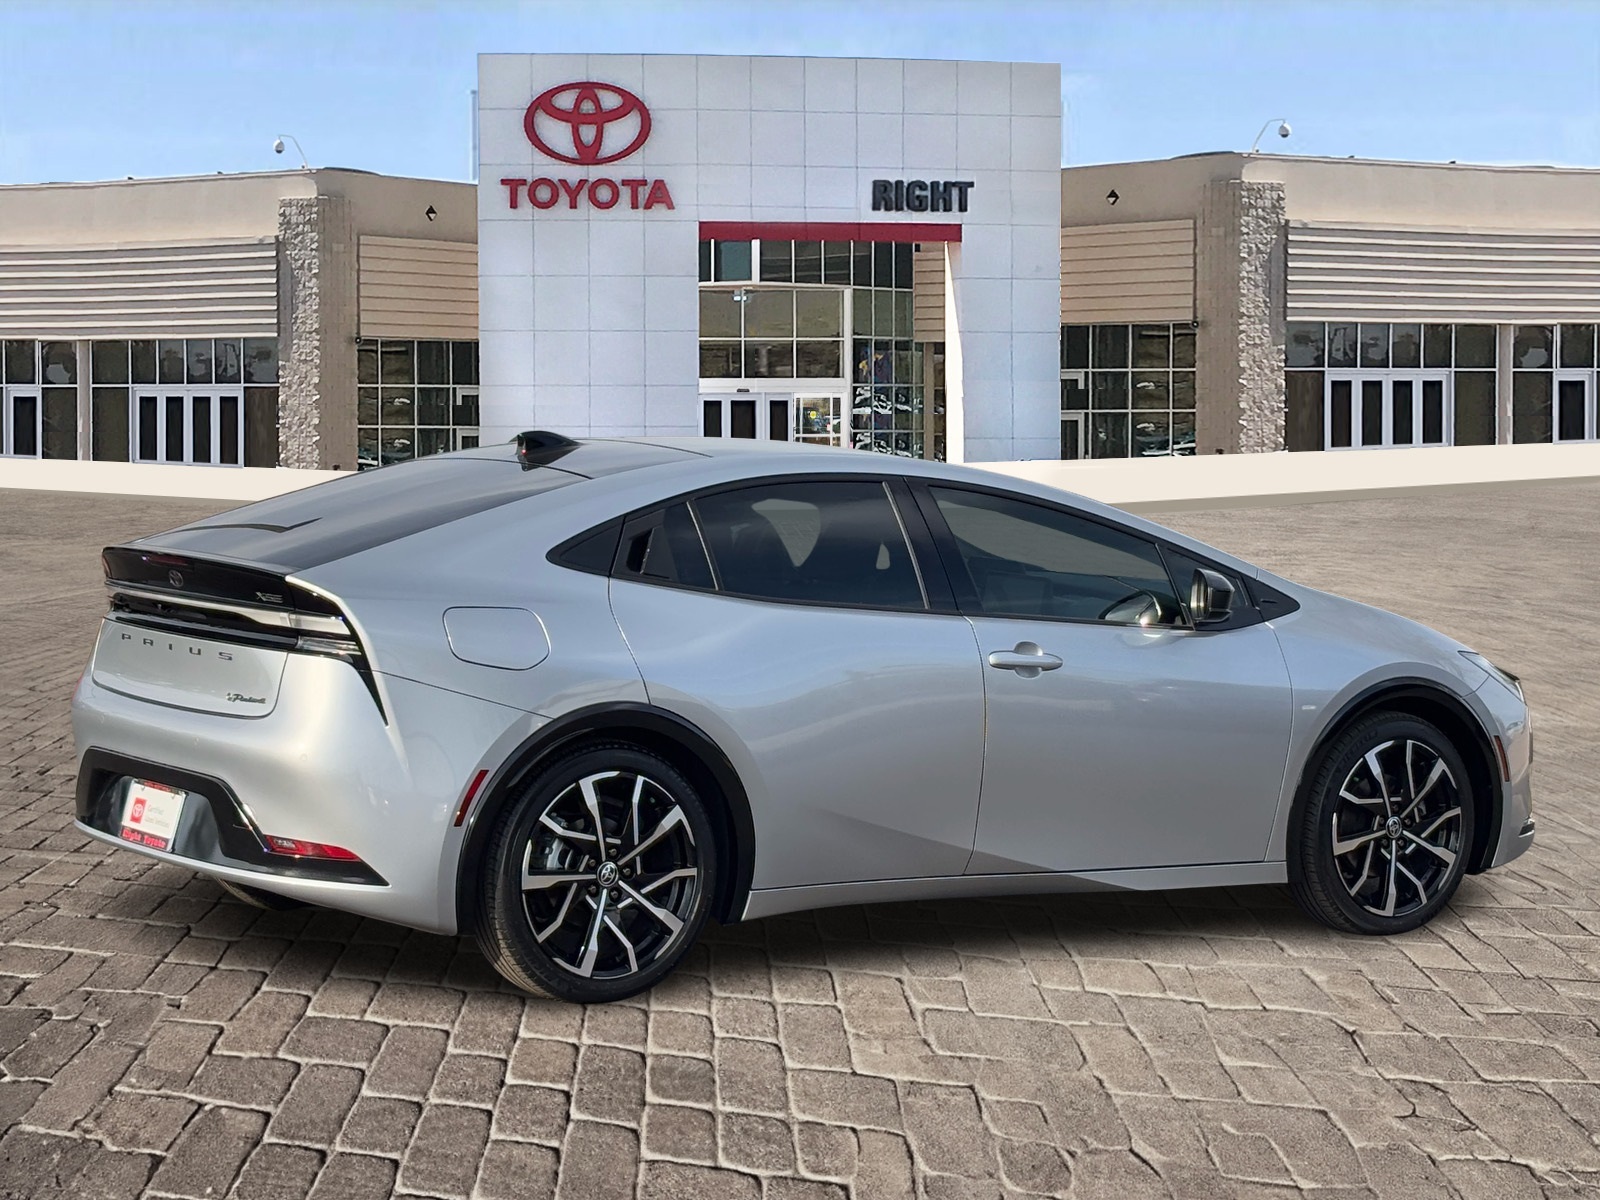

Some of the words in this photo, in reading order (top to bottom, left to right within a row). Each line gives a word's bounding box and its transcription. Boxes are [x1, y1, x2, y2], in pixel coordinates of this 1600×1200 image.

[500, 178, 676, 211] TOYOTA
[871, 179, 976, 213] RIGHT
[255, 591, 283, 604] XSE
[121, 633, 233, 661] PRIUS
